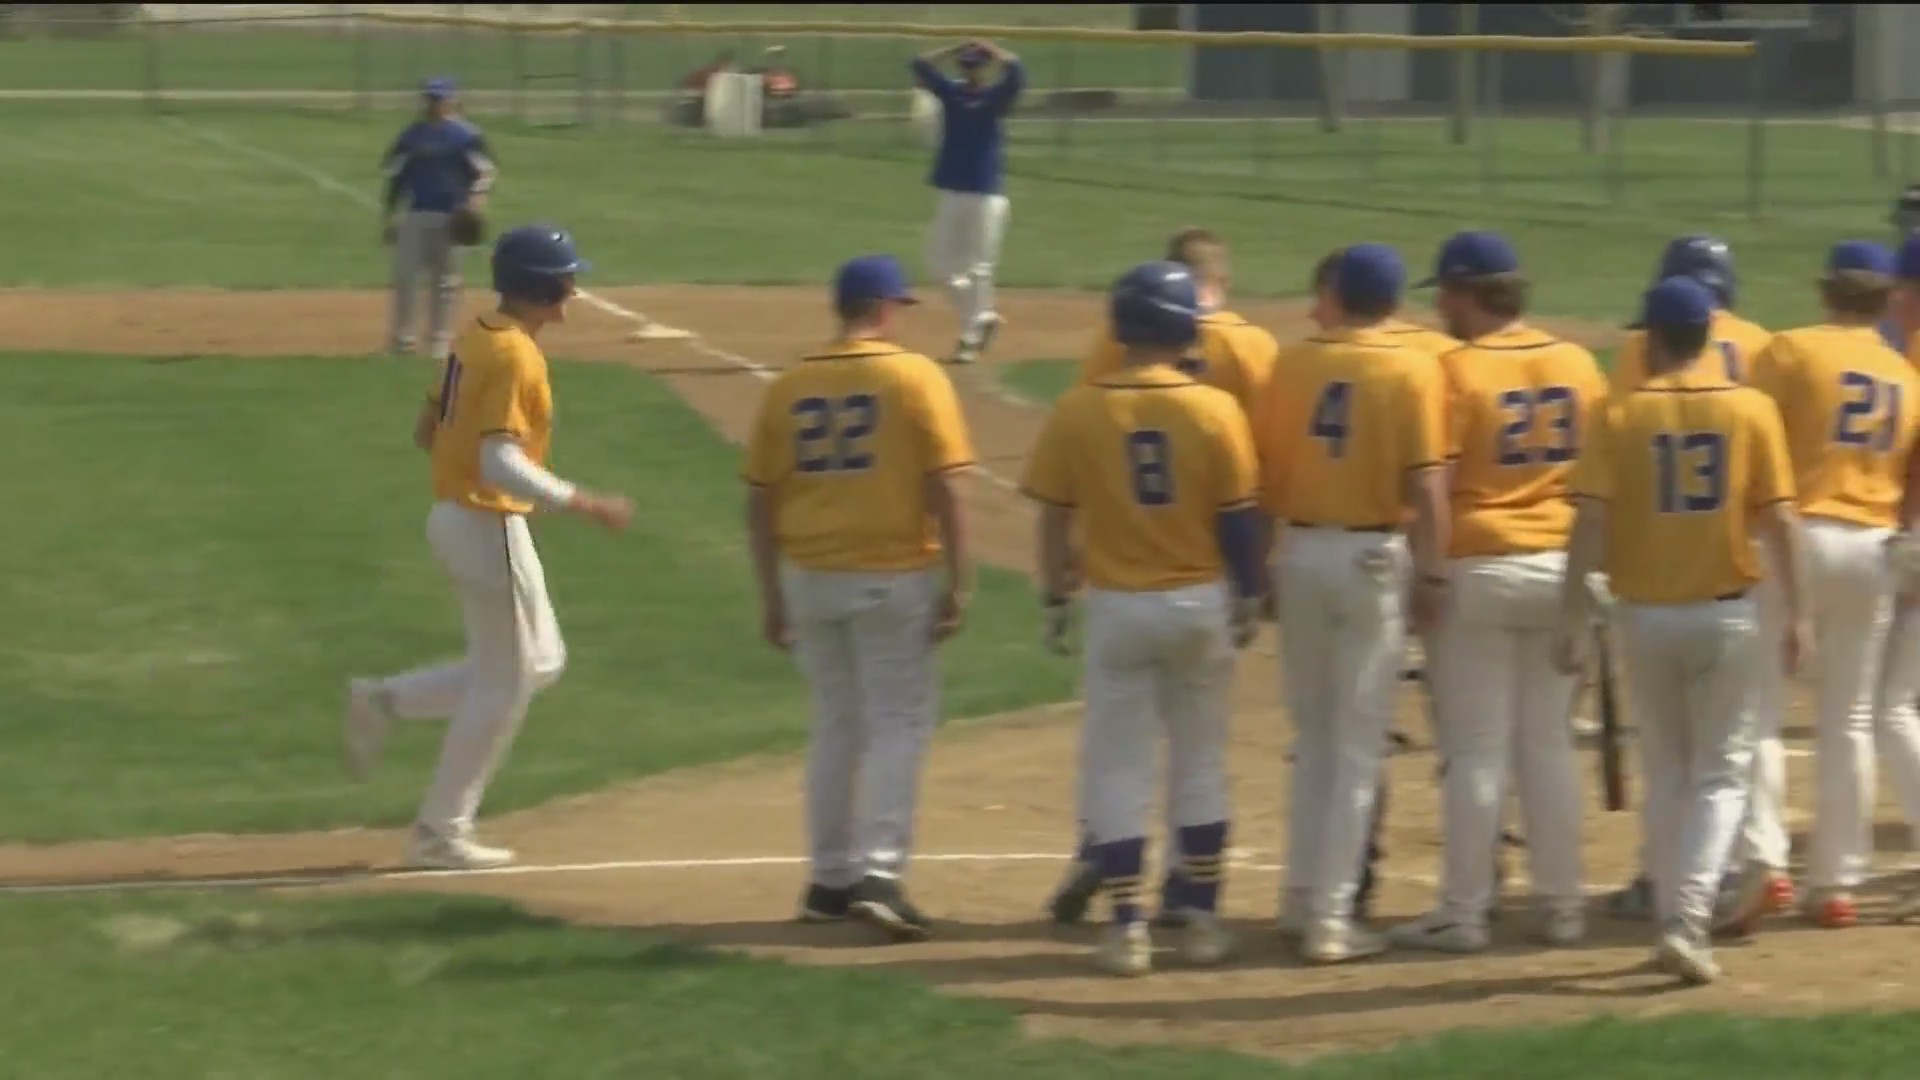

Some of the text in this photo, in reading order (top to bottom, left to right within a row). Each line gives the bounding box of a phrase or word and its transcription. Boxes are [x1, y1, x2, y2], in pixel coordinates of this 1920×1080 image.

[791, 393, 879, 472] 22
[1307, 381, 1353, 459] 4
[1498, 386, 1578, 466] 23
[1835, 370, 1904, 450] 21
[1127, 429, 1175, 506] 8
[1652, 432, 1727, 513] 13
